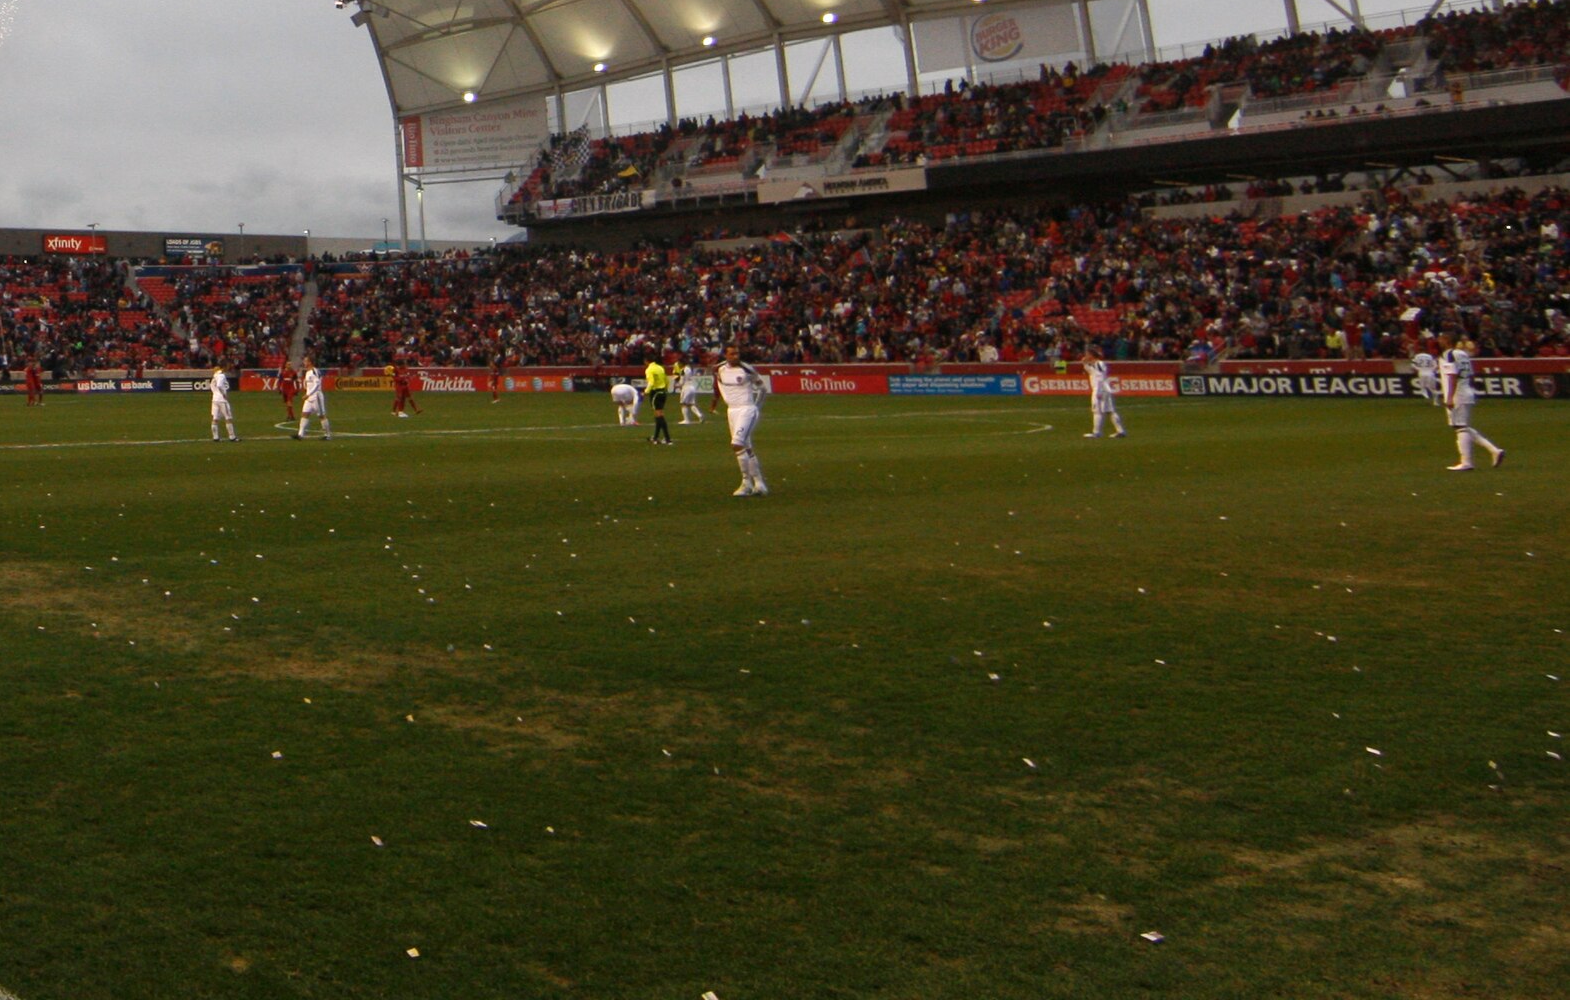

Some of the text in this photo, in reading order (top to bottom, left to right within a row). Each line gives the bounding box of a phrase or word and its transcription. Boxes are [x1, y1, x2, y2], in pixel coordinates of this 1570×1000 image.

[980, 26, 1021, 57] KING
[513, 109, 537, 119] Mine
[469, 123, 501, 134] Center
[47, 236, 82, 251] xfinity
[193, 378, 230, 391] adis
[336, 377, 380, 390] Continental
[1208, 377, 1522, 396] MAJOR LEAGUE SCER
